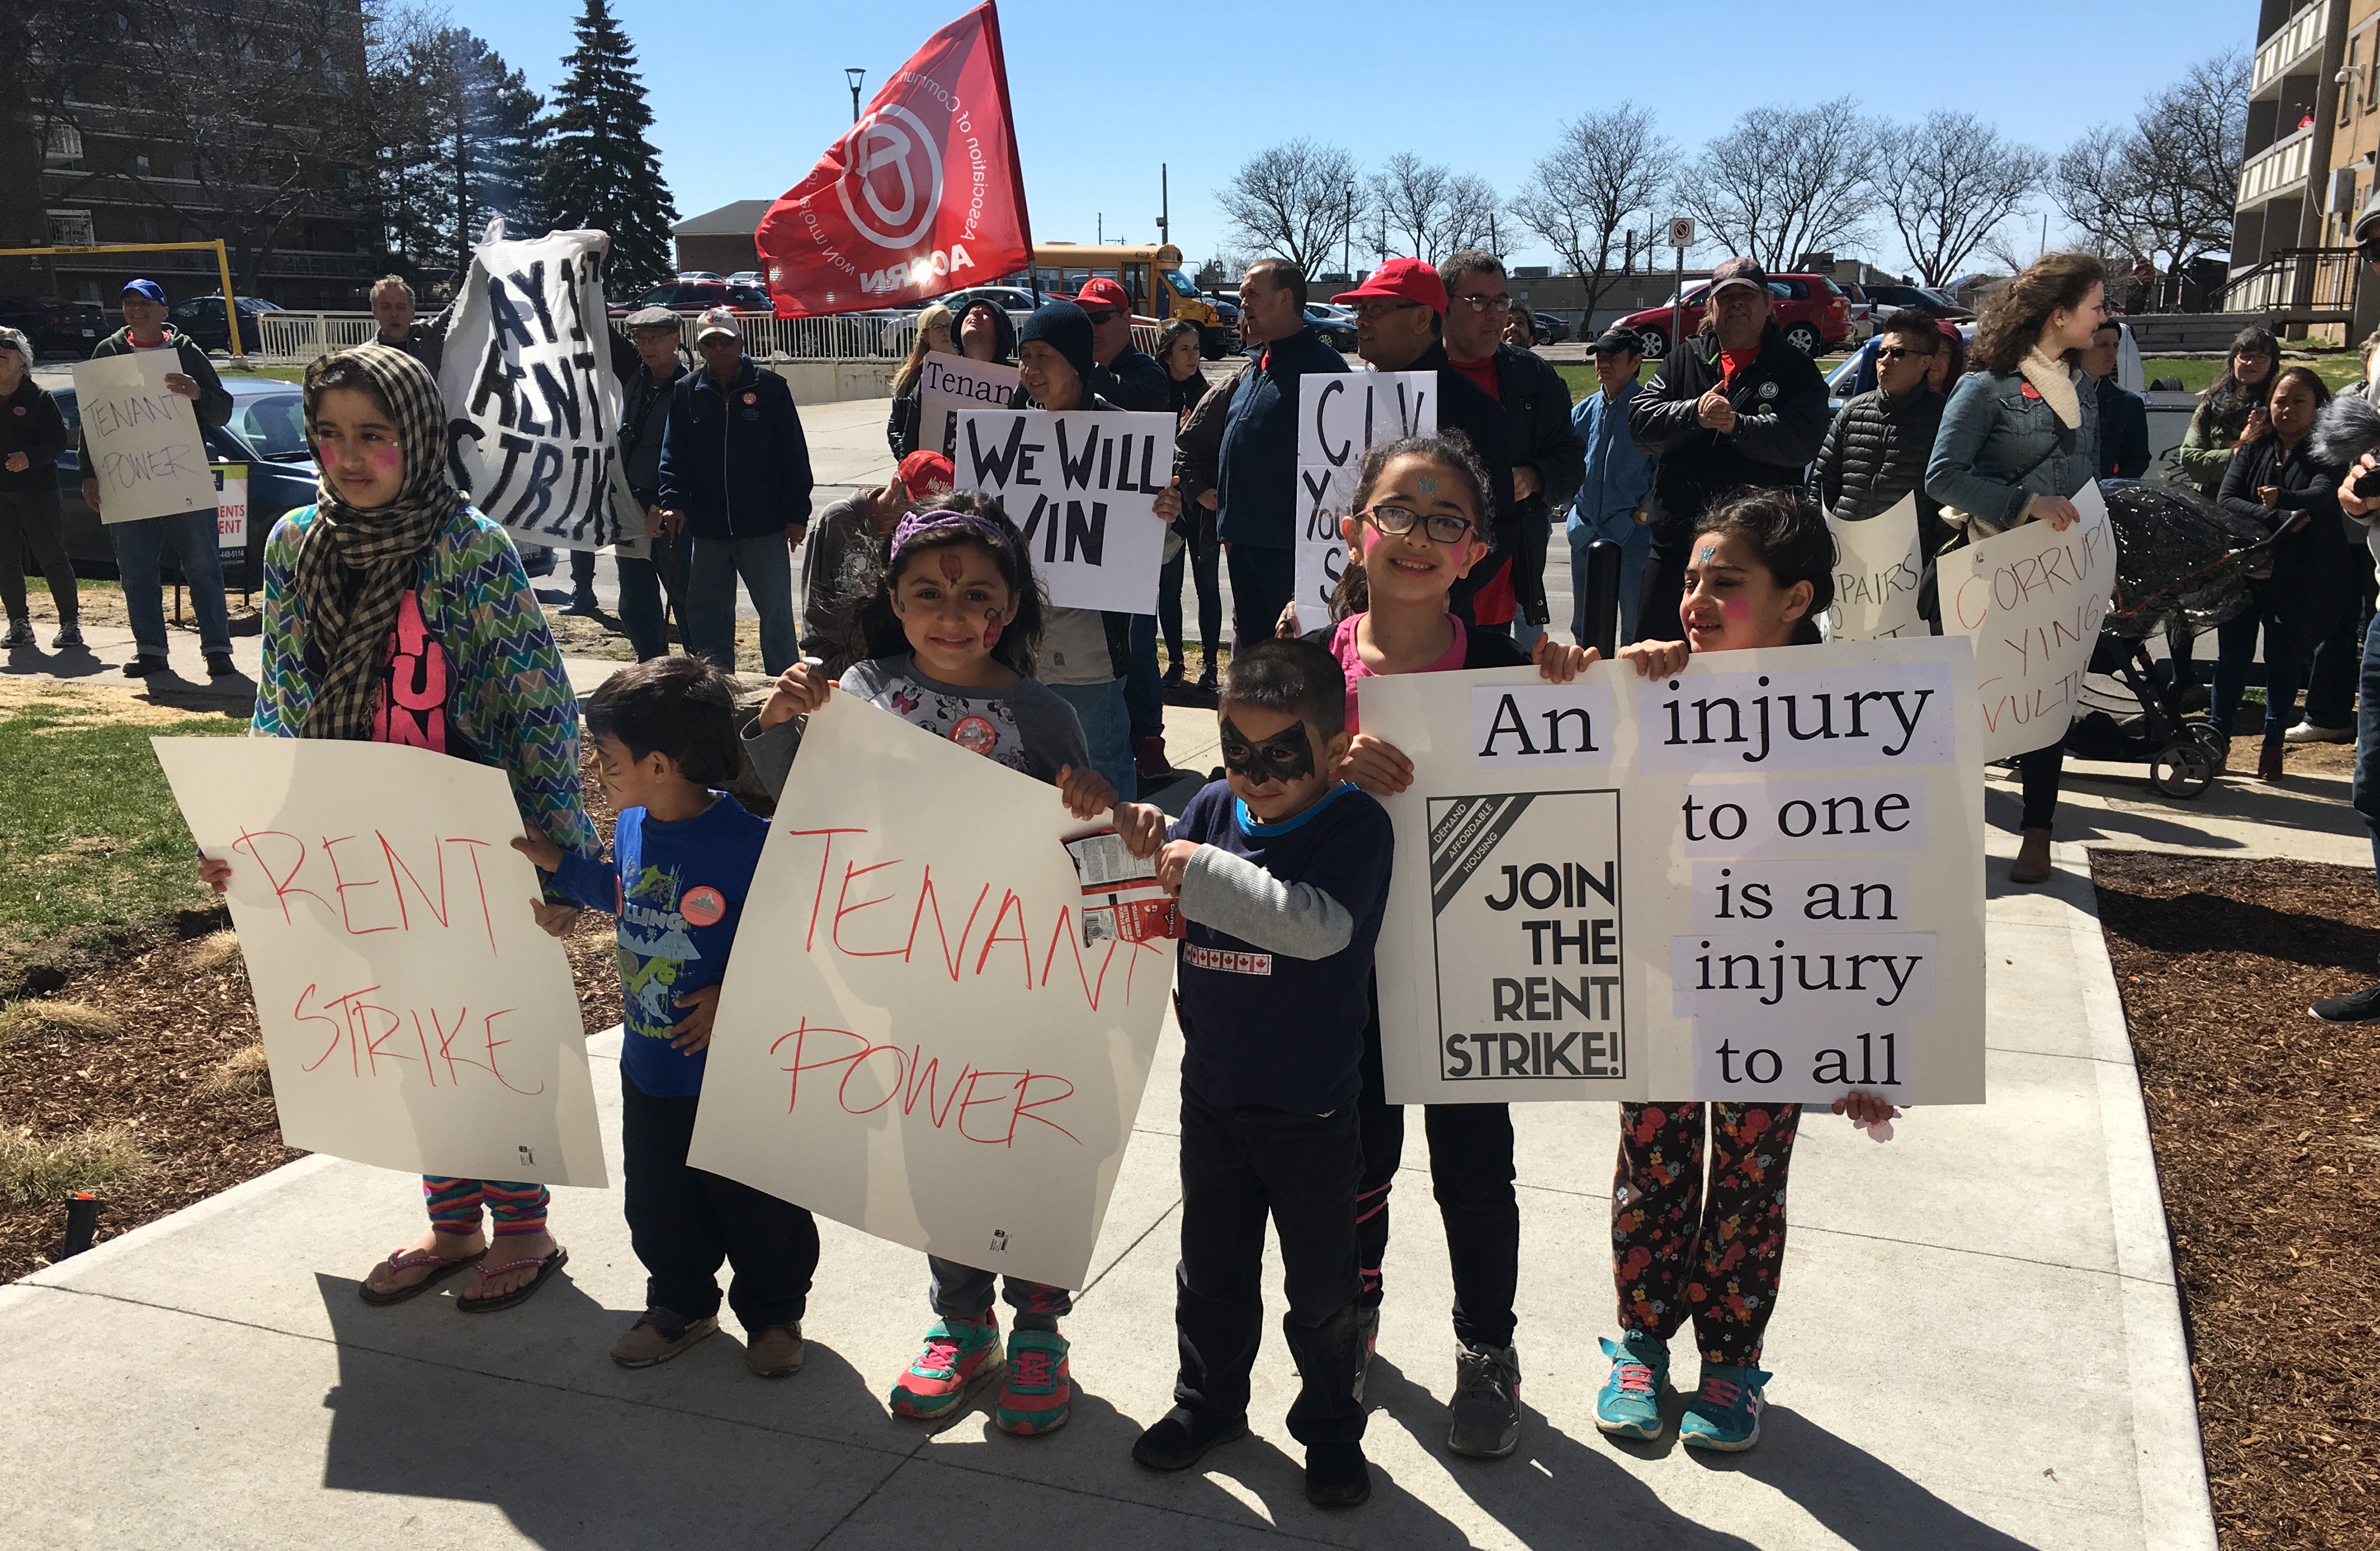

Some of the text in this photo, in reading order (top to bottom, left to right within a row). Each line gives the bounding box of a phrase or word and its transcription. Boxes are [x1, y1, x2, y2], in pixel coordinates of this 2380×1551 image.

[83, 393, 184, 438] TENANT
[103, 444, 202, 494] POWER
[447, 417, 635, 548] STRIKE
[966, 416, 1045, 490] WE
[1055, 417, 1166, 495] WILL
[217, 504, 246, 518] ENTS
[1836, 553, 1918, 605] PAIRS
[1956, 514, 2111, 630] CORRUPT
[1478, 674, 1935, 763] An injury
[1433, 803, 1467, 844] DEMAND
[1448, 803, 1495, 860] AFFORDABLE
[1682, 791, 1911, 841] to one
[1462, 831, 1498, 874] HOUSING
[231, 825, 498, 959] RENT
[1484, 860, 1616, 912] JOIN
[1715, 868, 1898, 922] is an
[789, 827, 1164, 1012] TENANT
[1522, 918, 1619, 966] THE
[1493, 975, 1620, 1022] RENT
[1695, 940, 1924, 1006] injury
[294, 982, 544, 1095] STRIKE
[1445, 1031, 1621, 1078] STRIKE!
[1716, 1032, 1902, 1086] to all
[770, 1016, 1084, 1149] POWER
